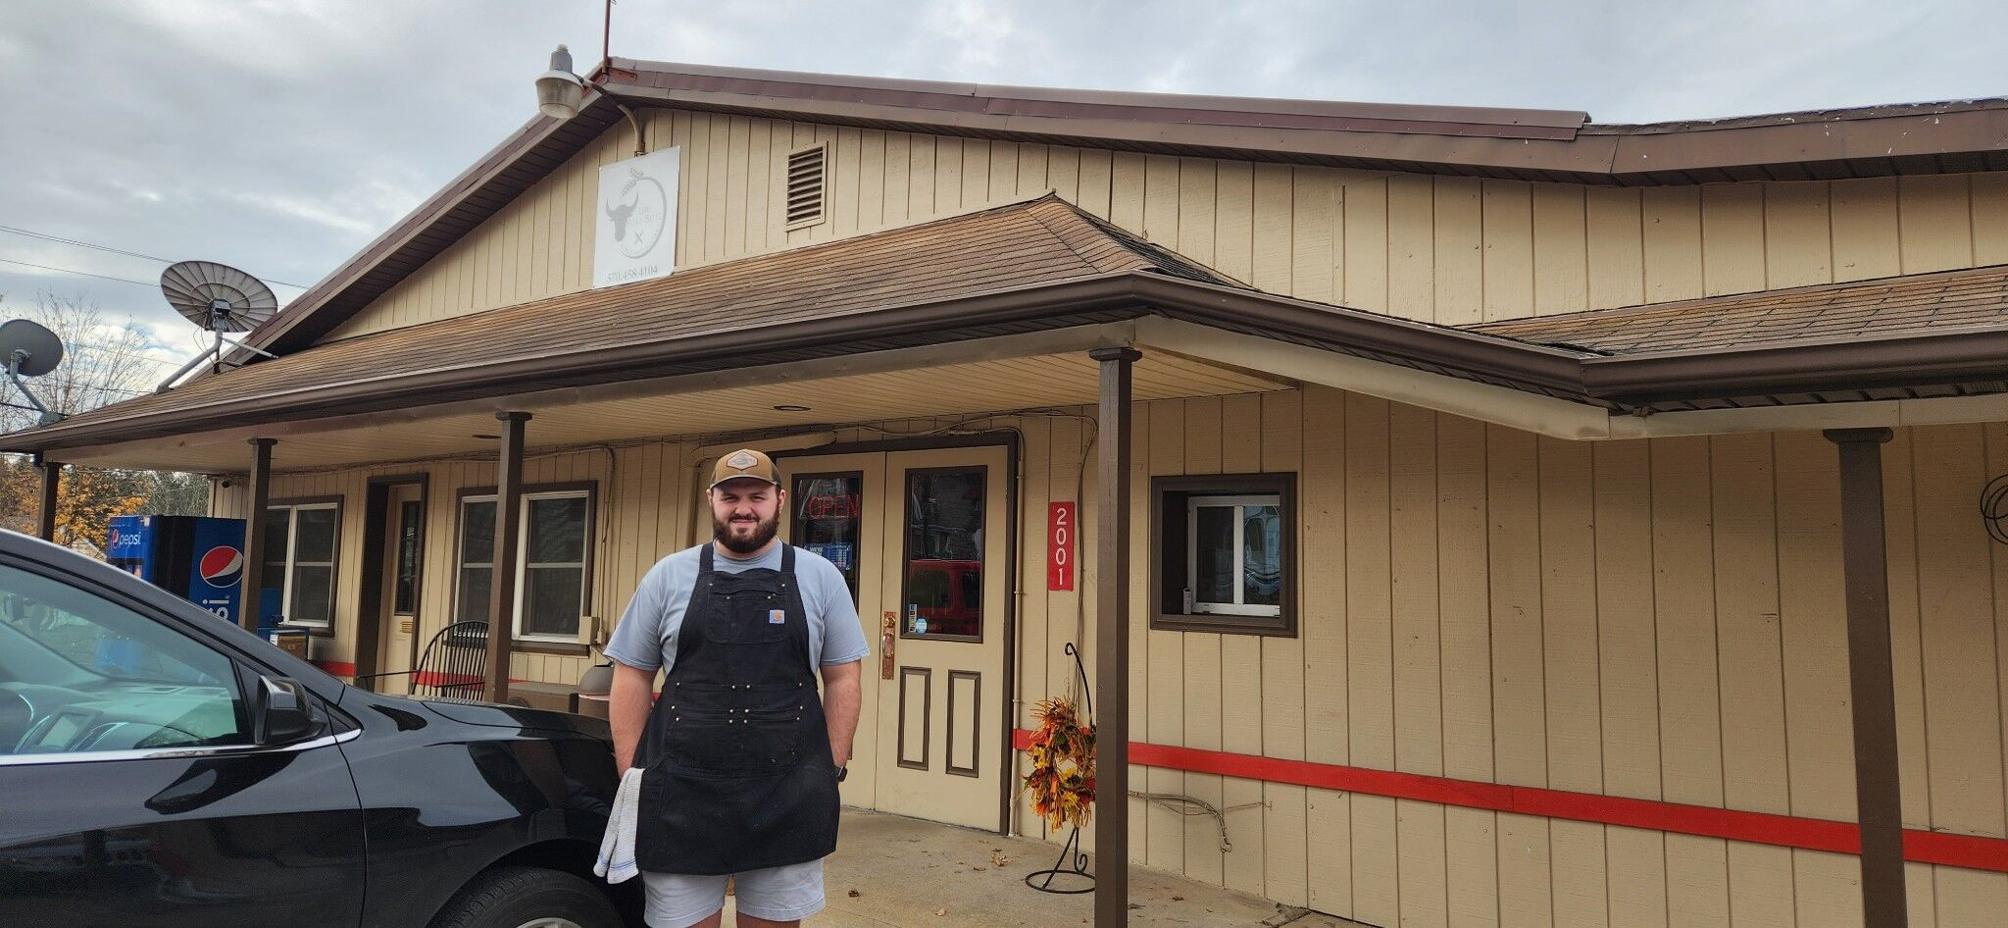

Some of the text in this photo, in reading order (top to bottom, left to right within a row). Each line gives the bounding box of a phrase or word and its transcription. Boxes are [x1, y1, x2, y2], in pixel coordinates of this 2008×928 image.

[807, 494, 859, 519] OPEN
[119, 531, 141, 548] pepsi
[1056, 507, 1067, 586] 2001
